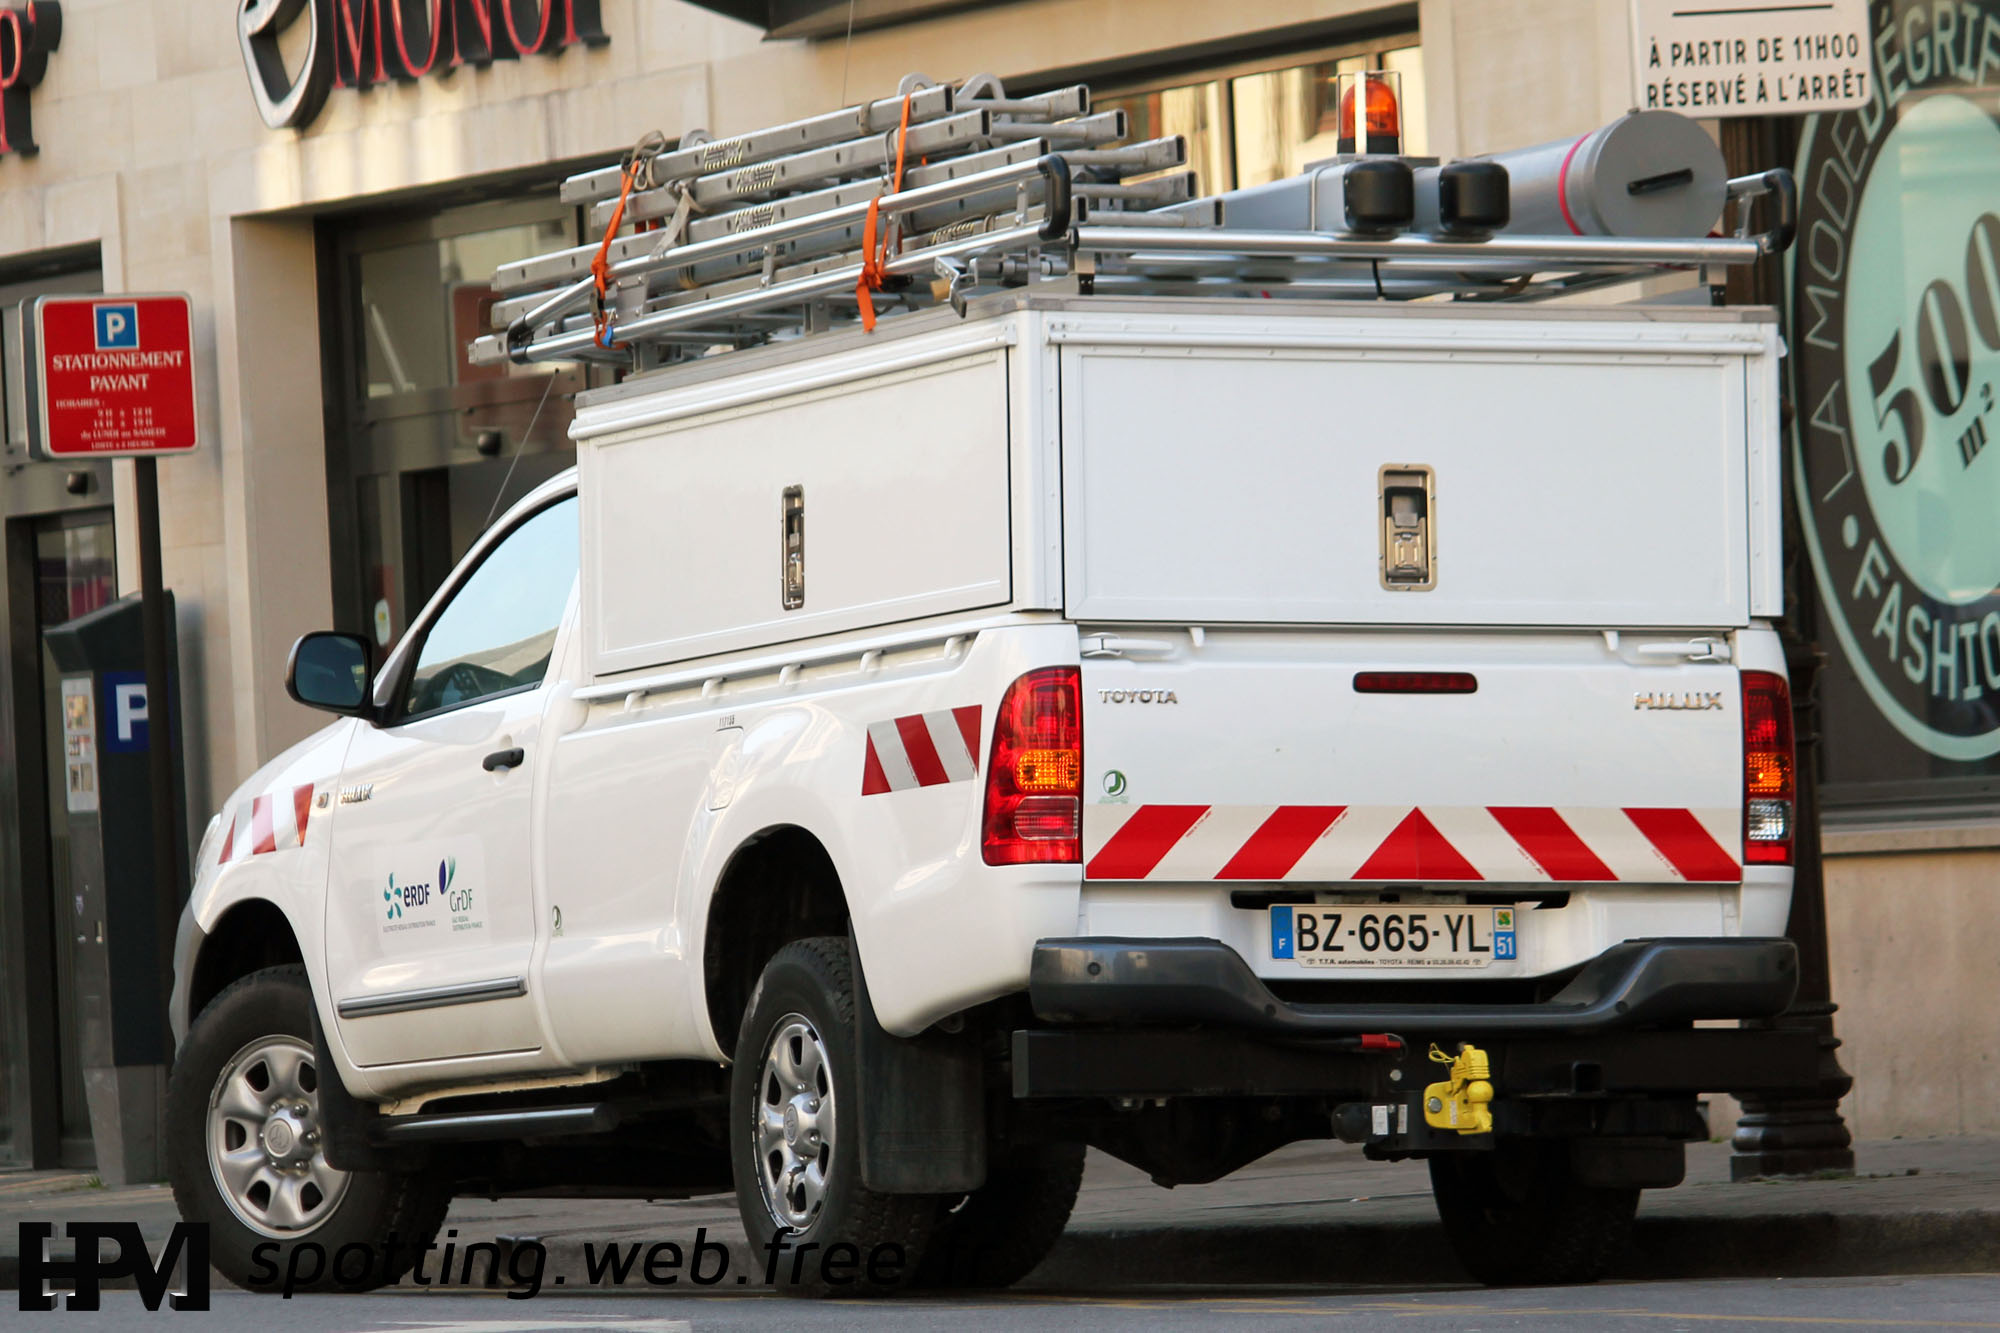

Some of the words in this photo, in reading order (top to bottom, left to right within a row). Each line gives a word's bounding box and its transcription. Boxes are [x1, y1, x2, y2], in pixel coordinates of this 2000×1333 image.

[1671, 39, 1747, 67] PARTIR
[1757, 37, 1784, 63] DE
[1793, 33, 1860, 61] 11H00
[1647, 73, 1747, 108] RÉSERVÉ
[1804, 111, 1870, 351] MODE
[106, 312, 126, 342] P
[52, 351, 184, 371] STATIONNEMENT
[90, 374, 149, 391] PAYANT
[1098, 688, 1178, 704] TOYOTA
[1633, 692, 1723, 710] HILUX
[115, 684, 149, 741] P
[449, 888, 472, 912] GrDF
[1278, 938, 1286, 950] F
[1297, 913, 1490, 952] BZ-665-YL
[1496, 936, 1513, 956] 51
